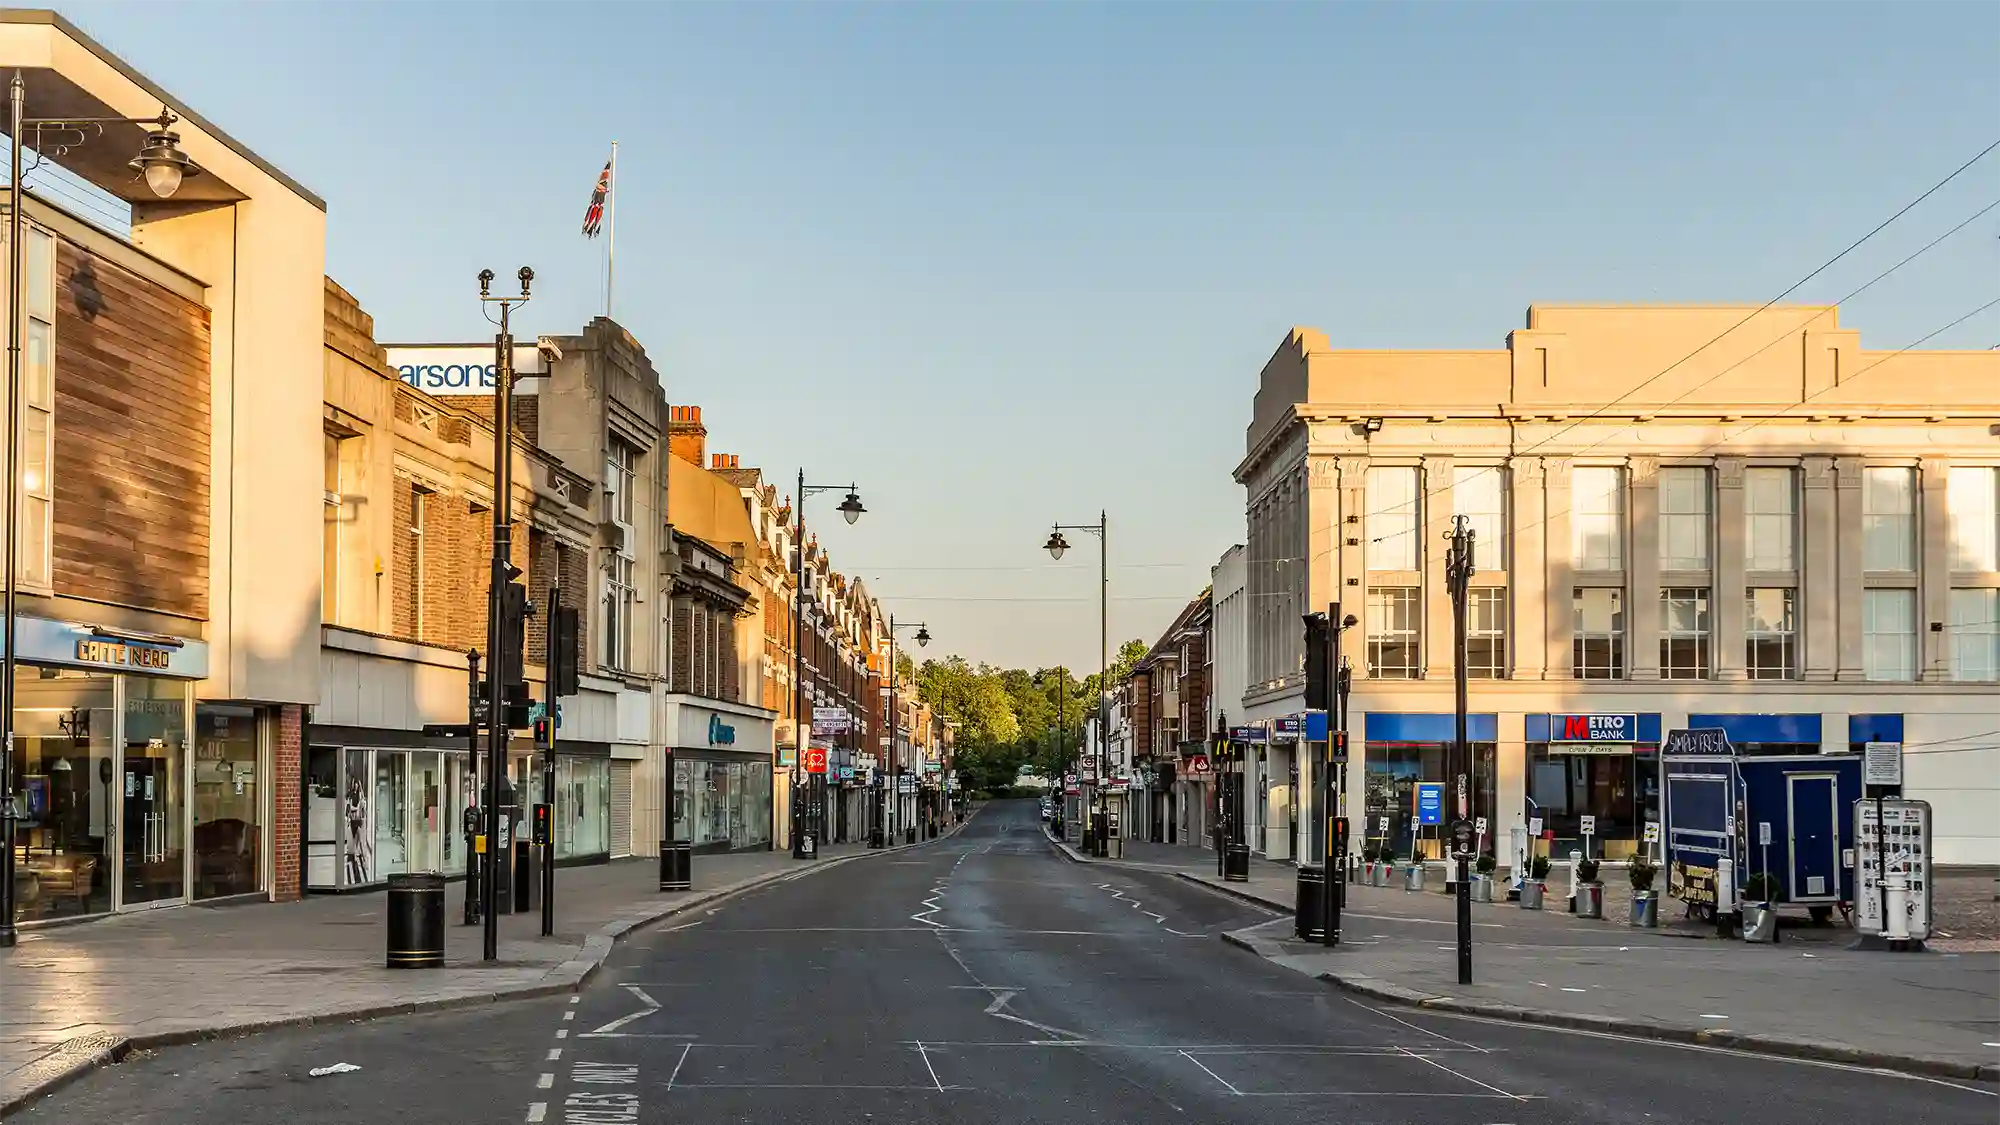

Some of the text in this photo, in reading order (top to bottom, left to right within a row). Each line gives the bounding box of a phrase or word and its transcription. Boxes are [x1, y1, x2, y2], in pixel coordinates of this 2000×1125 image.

[130, 646, 169, 669] NERO
[1564, 715, 1625, 739] METRO
[1590, 730, 1625, 739] BANK
[1669, 732, 1724, 753] SIMPLY FRESH
